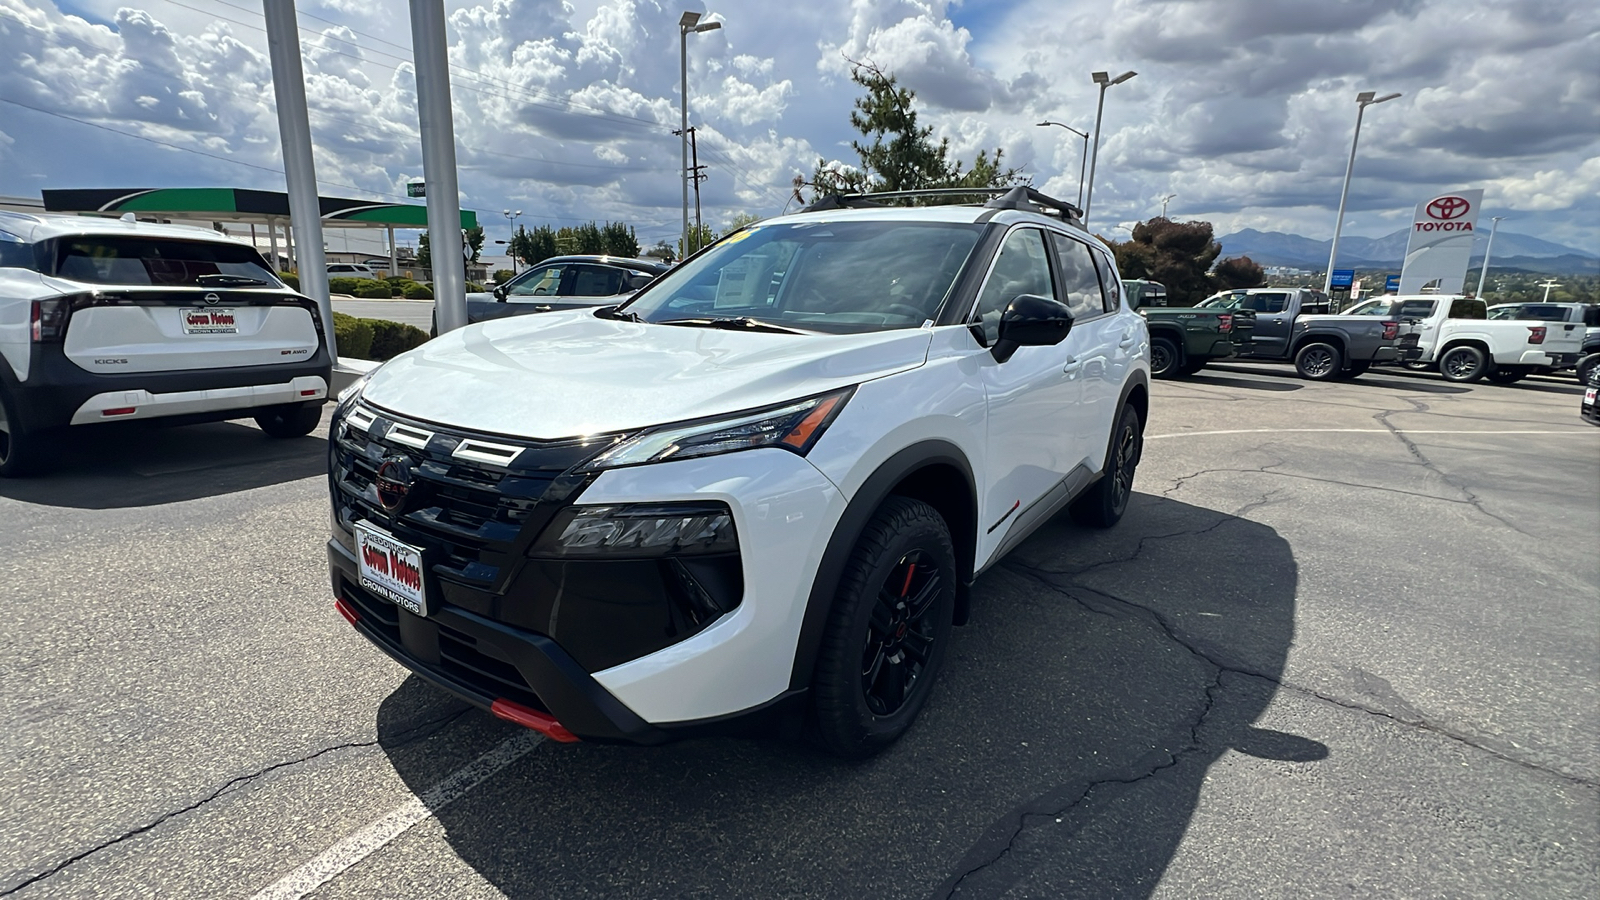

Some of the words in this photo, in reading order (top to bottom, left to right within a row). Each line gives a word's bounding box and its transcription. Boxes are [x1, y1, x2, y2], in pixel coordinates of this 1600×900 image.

[1415, 222, 1472, 231] TOYOTA
[368, 533, 402, 554] REDDING
[389, 549, 421, 592] Motors
[362, 578, 388, 597] CROWN
[389, 591, 419, 612] MOTORS
